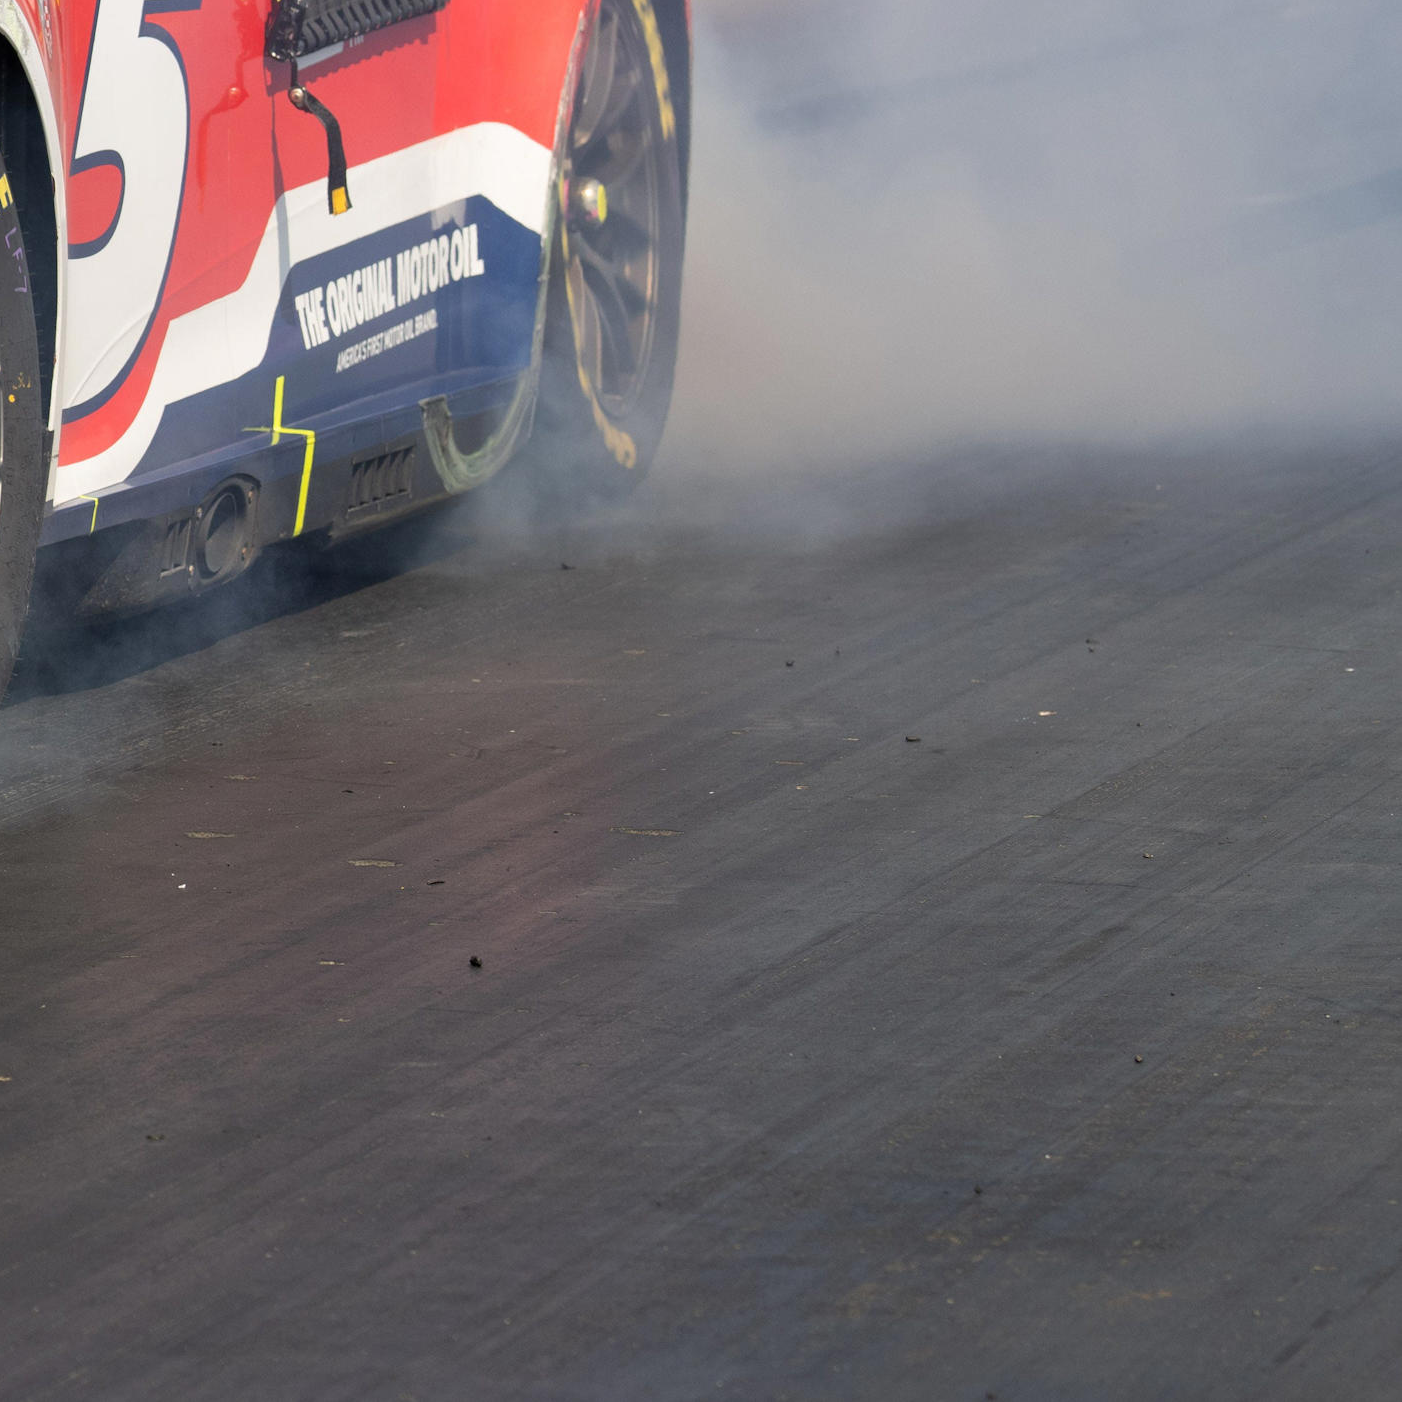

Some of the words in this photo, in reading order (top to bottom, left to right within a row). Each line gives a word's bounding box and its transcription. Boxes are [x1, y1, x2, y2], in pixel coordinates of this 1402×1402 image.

[295, 287, 330, 350] THE
[326, 257, 395, 337] ORIGINAL
[397, 235, 450, 307] MOTOR
[450, 223, 485, 281] OIL
[365, 332, 384, 359] FIRST
[383, 323, 405, 350] MOTOR
[404, 318, 415, 341] OIL
